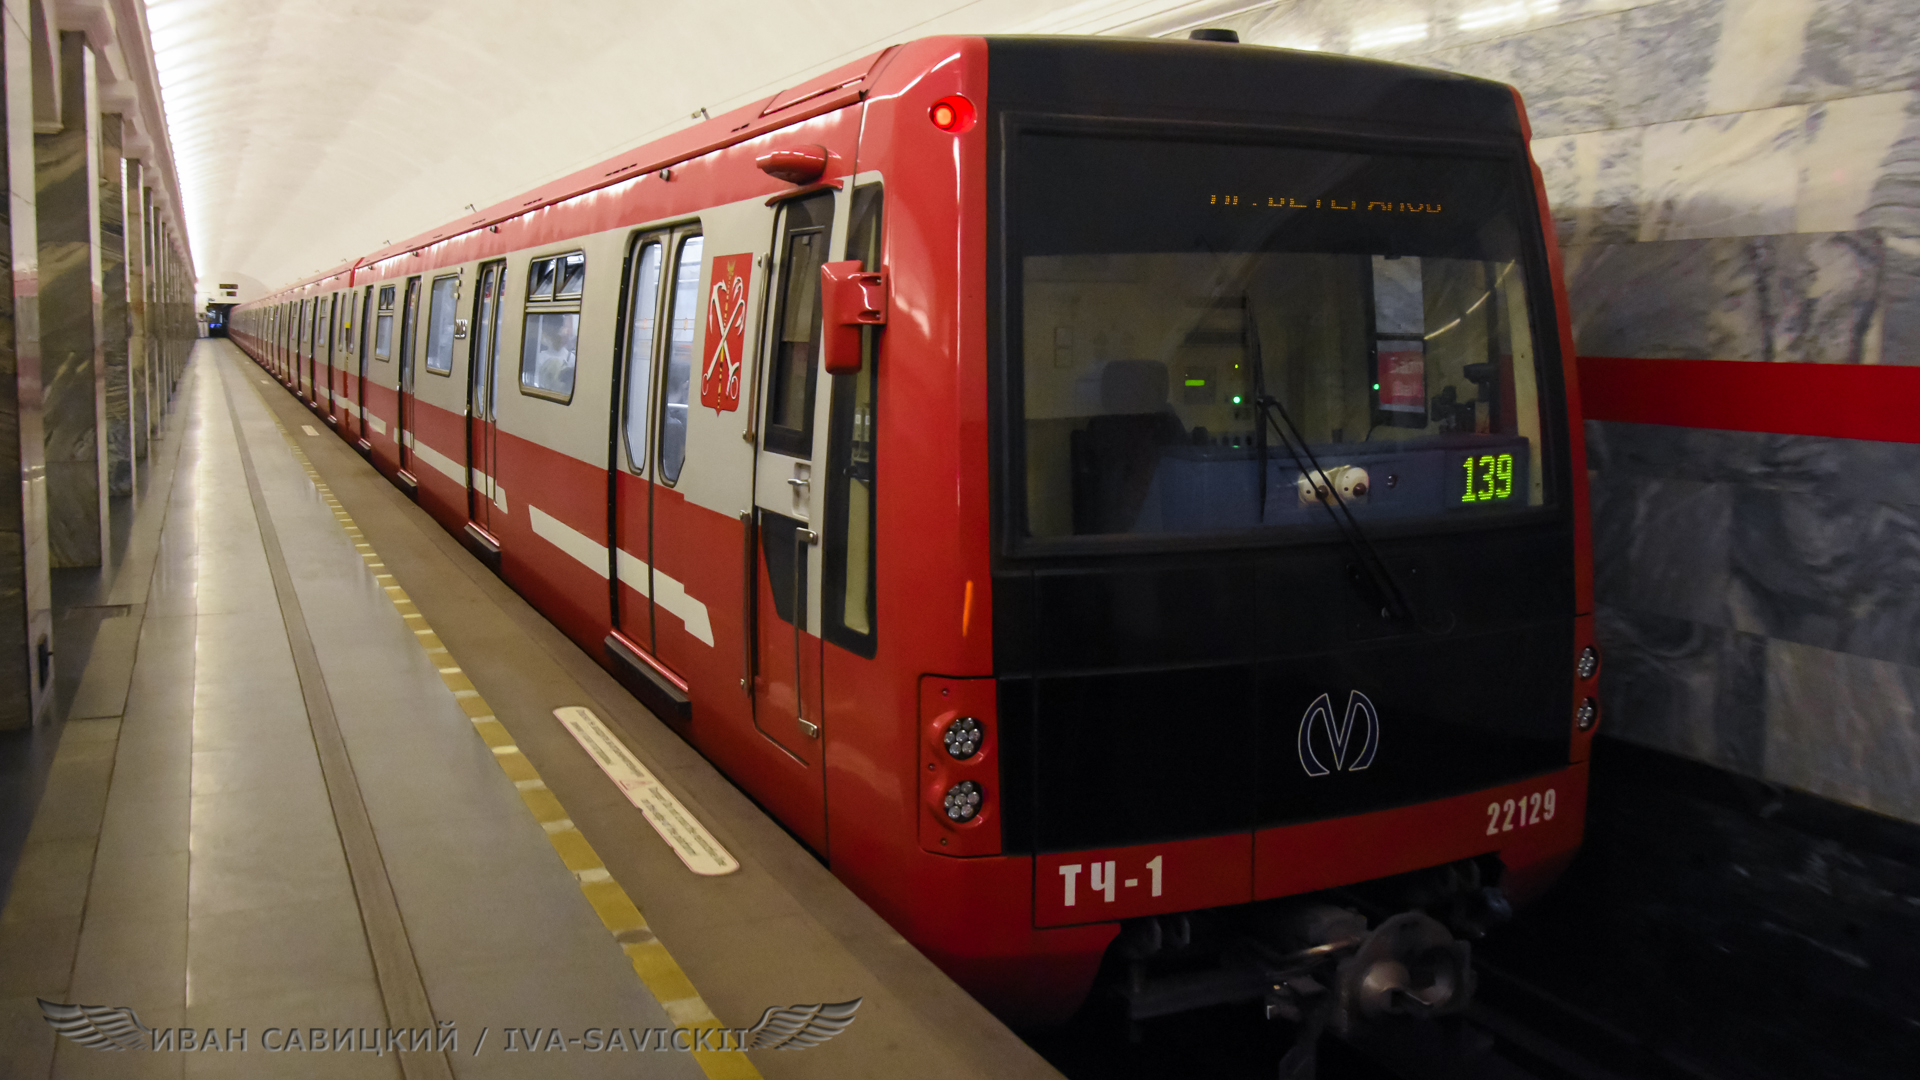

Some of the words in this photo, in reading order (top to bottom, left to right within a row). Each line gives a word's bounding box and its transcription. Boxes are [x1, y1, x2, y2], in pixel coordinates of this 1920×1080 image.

[1461, 453, 1514, 503] 139
[1486, 788, 1556, 836] 22129
[1058, 855, 1163, 907] ТЧ-1
